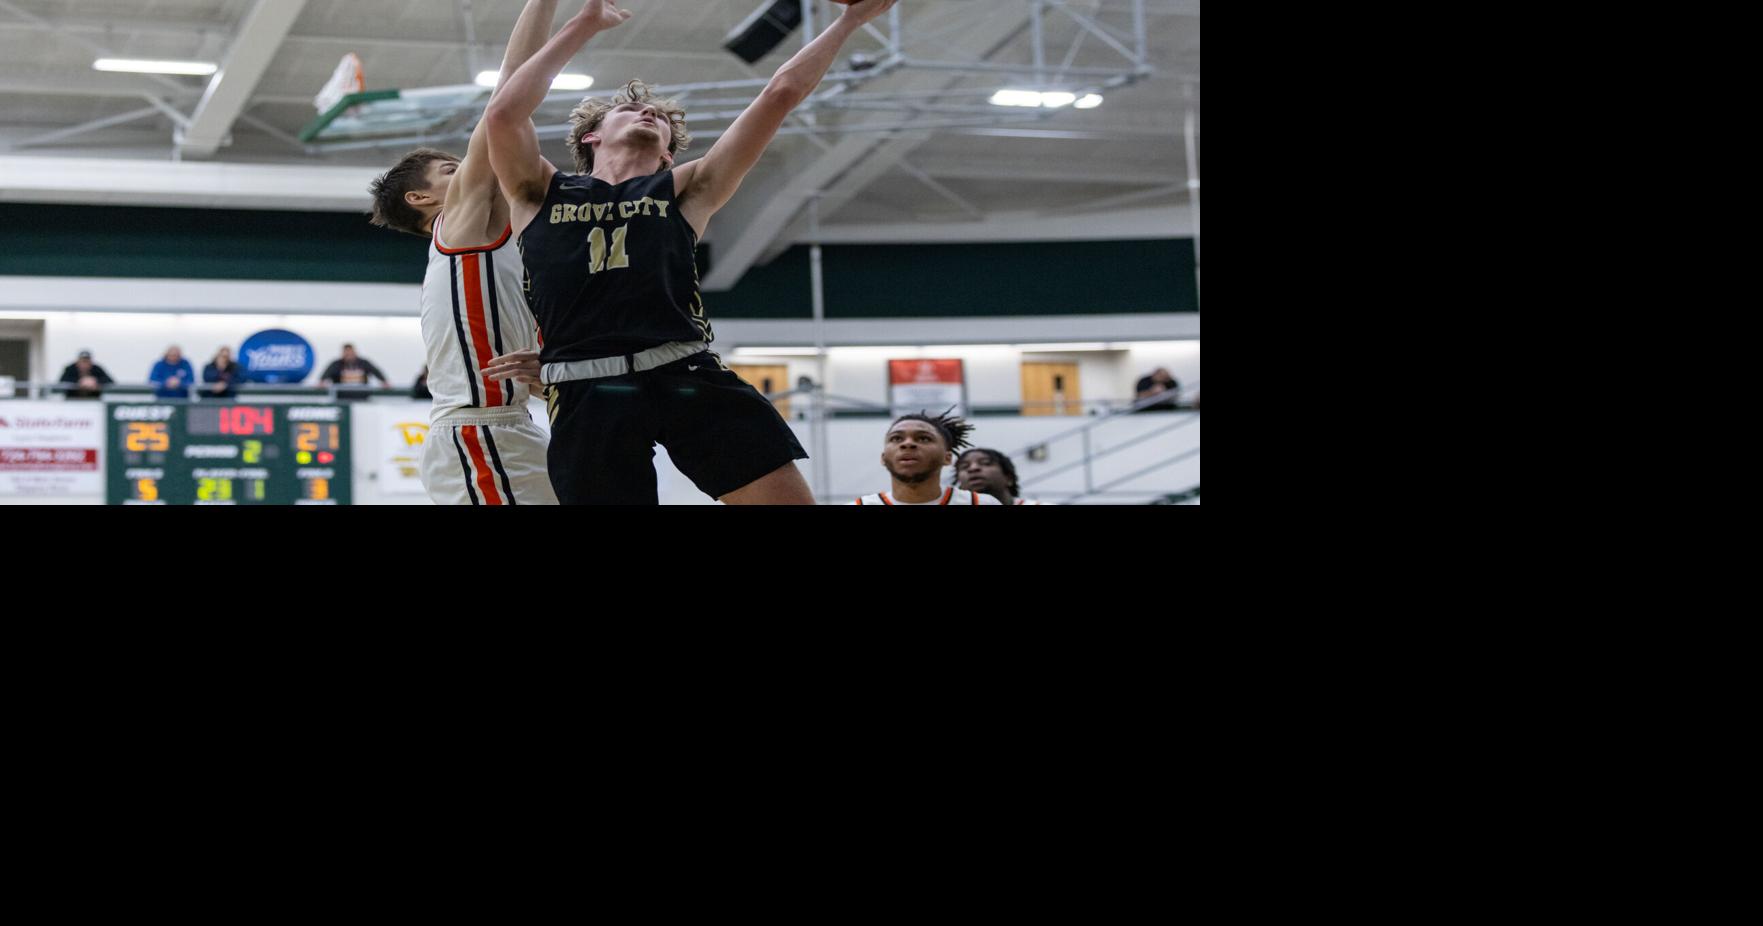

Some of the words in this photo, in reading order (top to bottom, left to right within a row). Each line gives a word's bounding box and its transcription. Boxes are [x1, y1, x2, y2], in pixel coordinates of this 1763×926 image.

[618, 196, 669, 219] CITY
[587, 222, 630, 274] 11
[219, 406, 274, 435] 104
[126, 422, 170, 451] 25
[296, 422, 340, 452] 21
[242, 440, 262, 463] 2
[137, 478, 158, 501] 5
